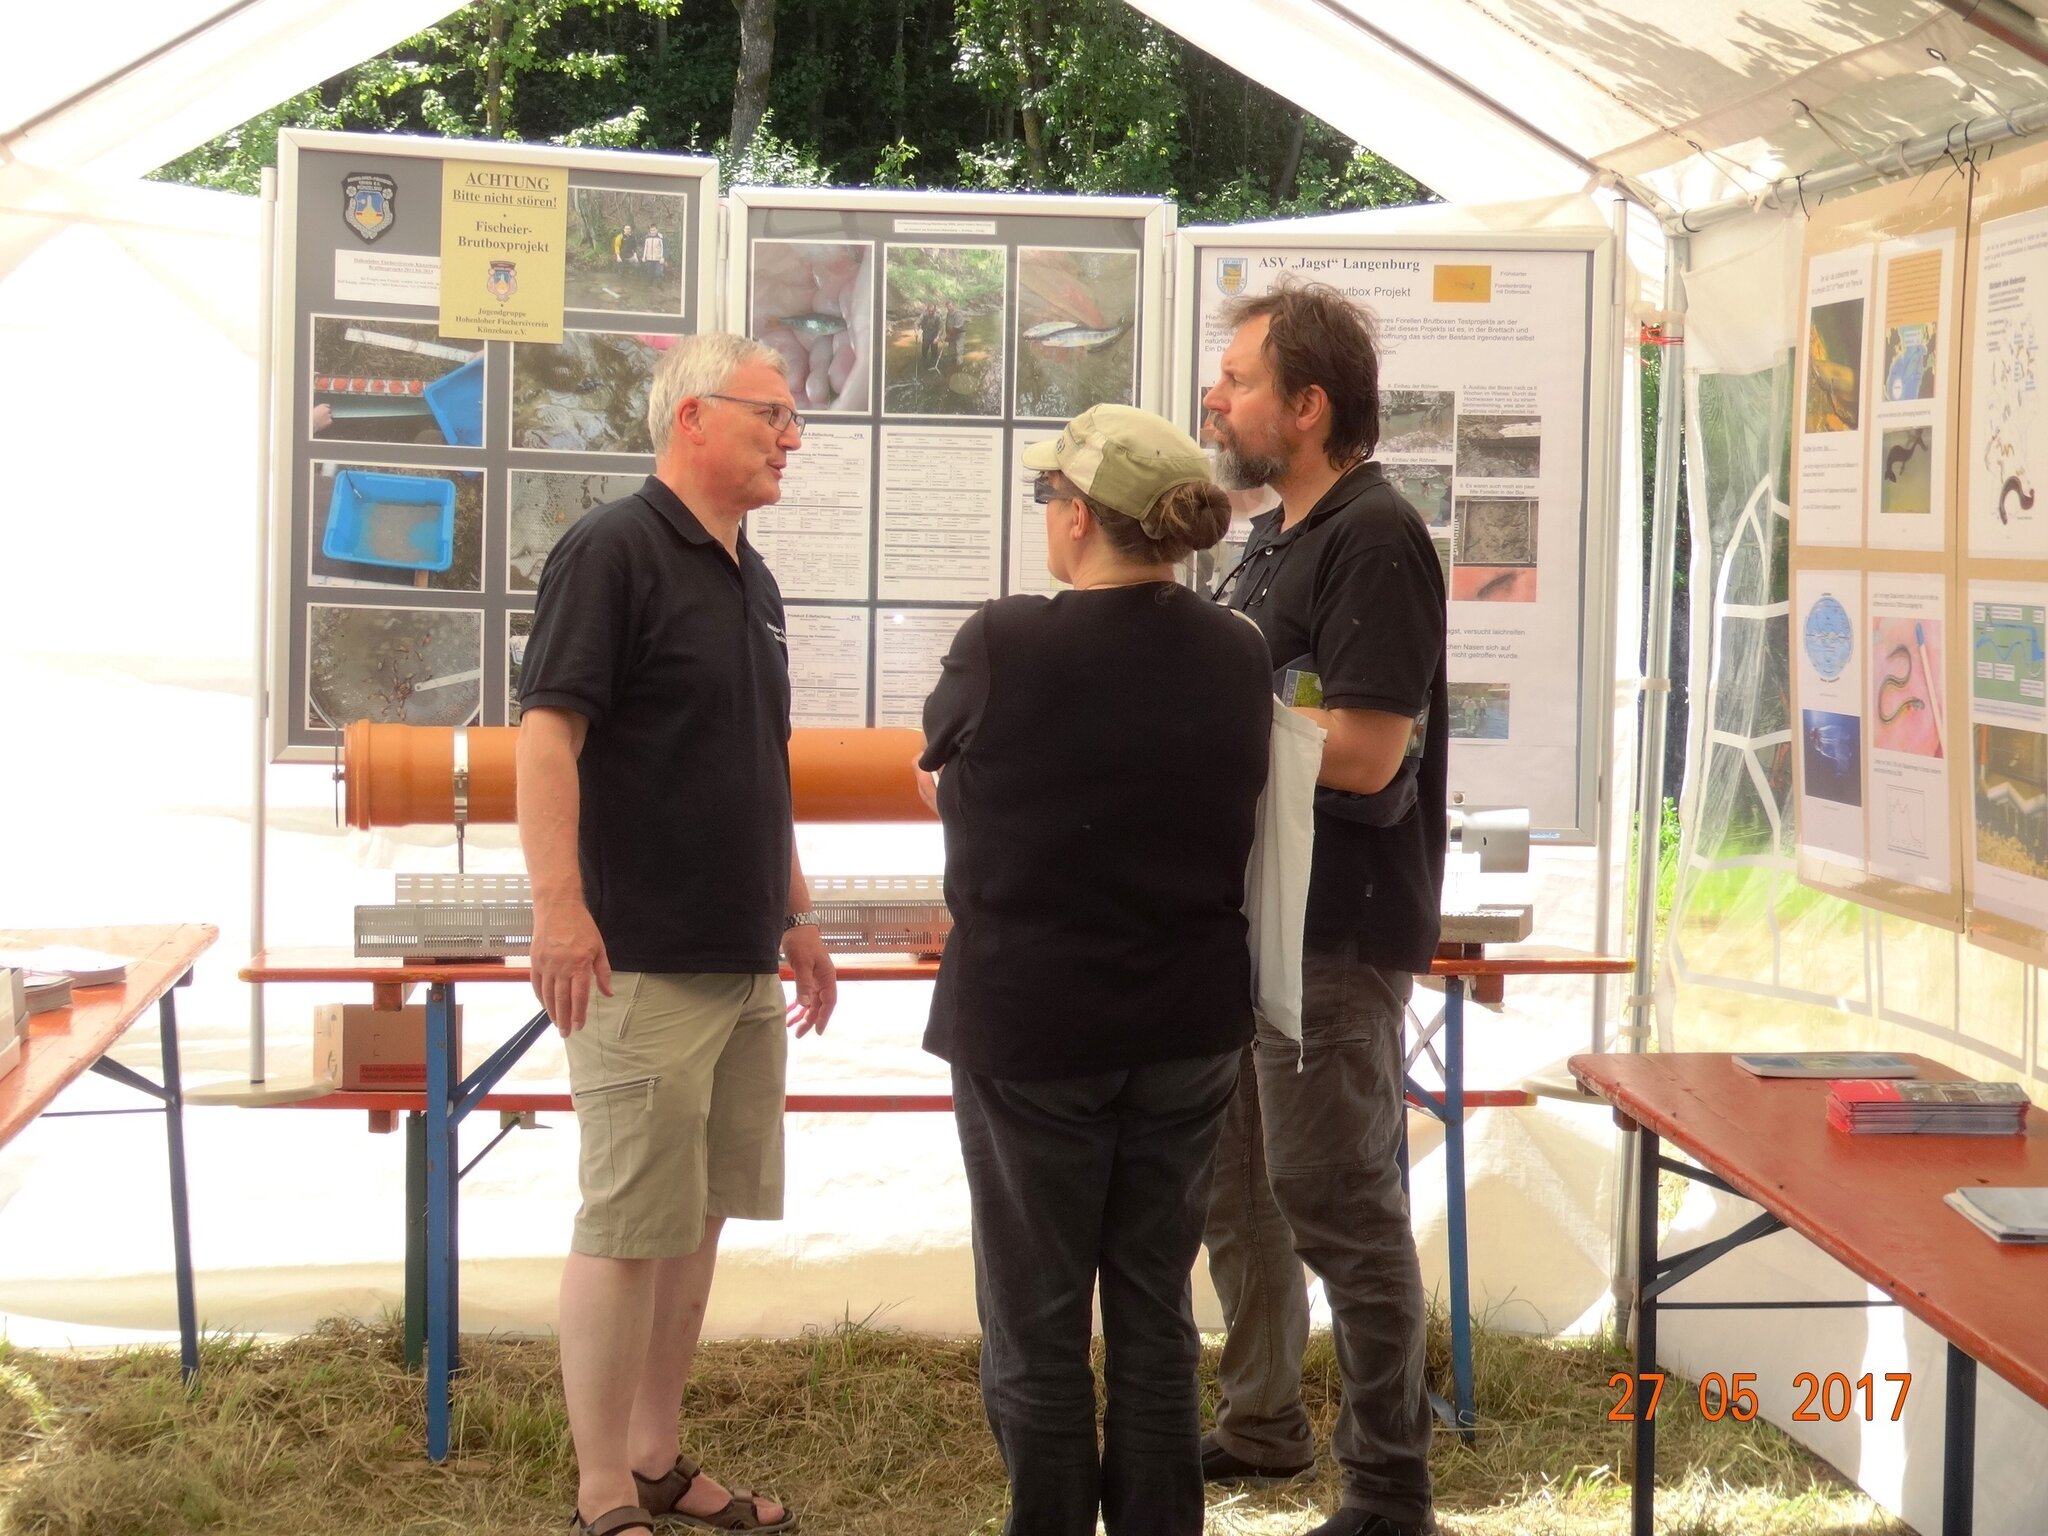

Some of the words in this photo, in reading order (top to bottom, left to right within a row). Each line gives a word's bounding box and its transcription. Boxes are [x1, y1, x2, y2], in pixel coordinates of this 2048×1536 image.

[465, 171, 550, 191] ACHTUNG
[453, 189, 481, 202] Bitte
[484, 193, 513, 204] nicht
[516, 196, 557, 208] stören!
[475, 220, 533, 235] Fischeier-
[458, 235, 549, 253] Brutboxprojekt
[1258, 257, 1288, 268] ASV
[1343, 258, 1421, 272] Langenburg
[1333, 286, 1371, 297] rutbox
[1374, 286, 1411, 299] Projekt
[478, 307, 527, 318] Jugendgruppe
[455, 315, 495, 325] Hohenloher
[1396, 317, 1421, 325] Forellen
[477, 325, 513, 335] Künzelsau
[1420, 325, 1447, 333] Projekts
[1477, 334, 1514, 342] irgendwann
[1447, 628, 1462, 636] agst,
[1464, 628, 1491, 636] versucht
[1468, 651, 1497, 660] getroffen
